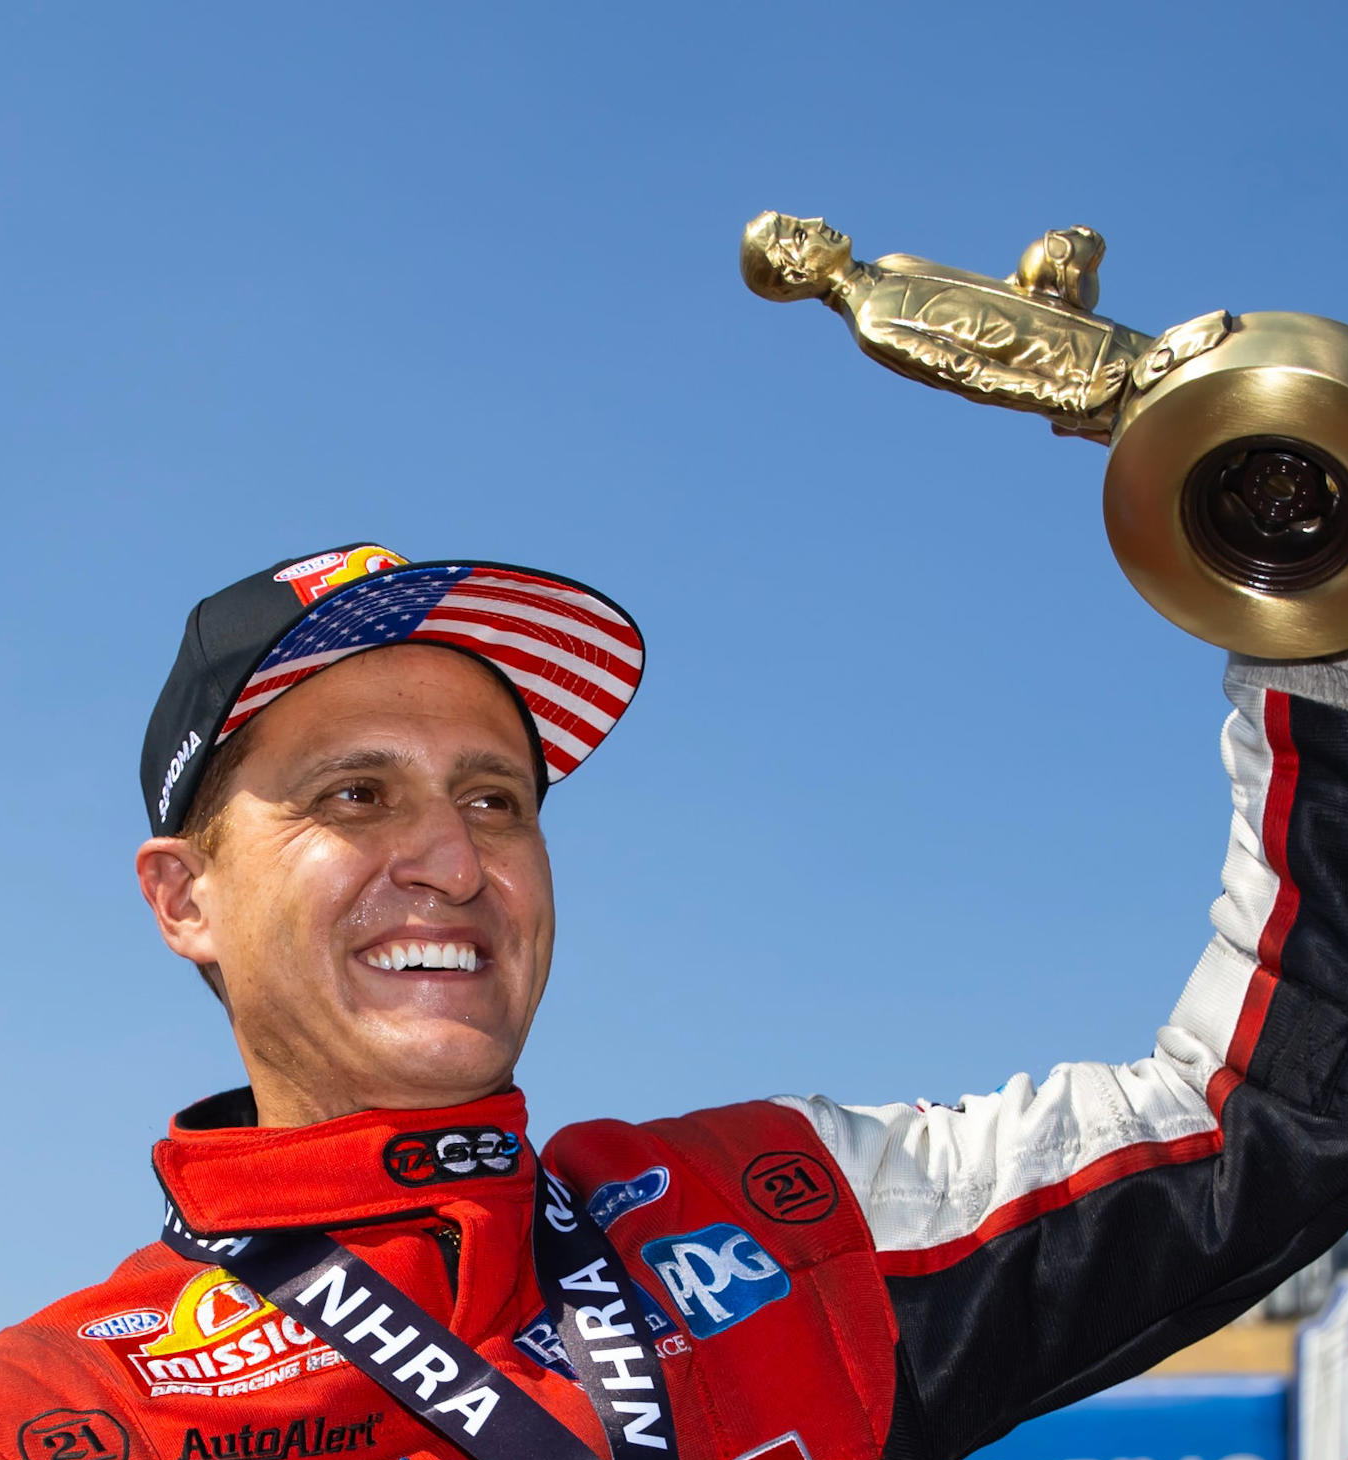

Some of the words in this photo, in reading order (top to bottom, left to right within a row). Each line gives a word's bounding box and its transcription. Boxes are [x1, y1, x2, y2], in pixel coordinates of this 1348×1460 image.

[764, 1166, 819, 1208] 21
[655, 1233, 781, 1324] PPG
[90, 1312, 162, 1338] NHRA
[147, 1315, 317, 1380] MISSIO
[295, 1264, 501, 1437] NHRA
[558, 1256, 668, 1451] NHRA
[217, 1361, 302, 1398] RACING
[306, 1349, 349, 1372] SER
